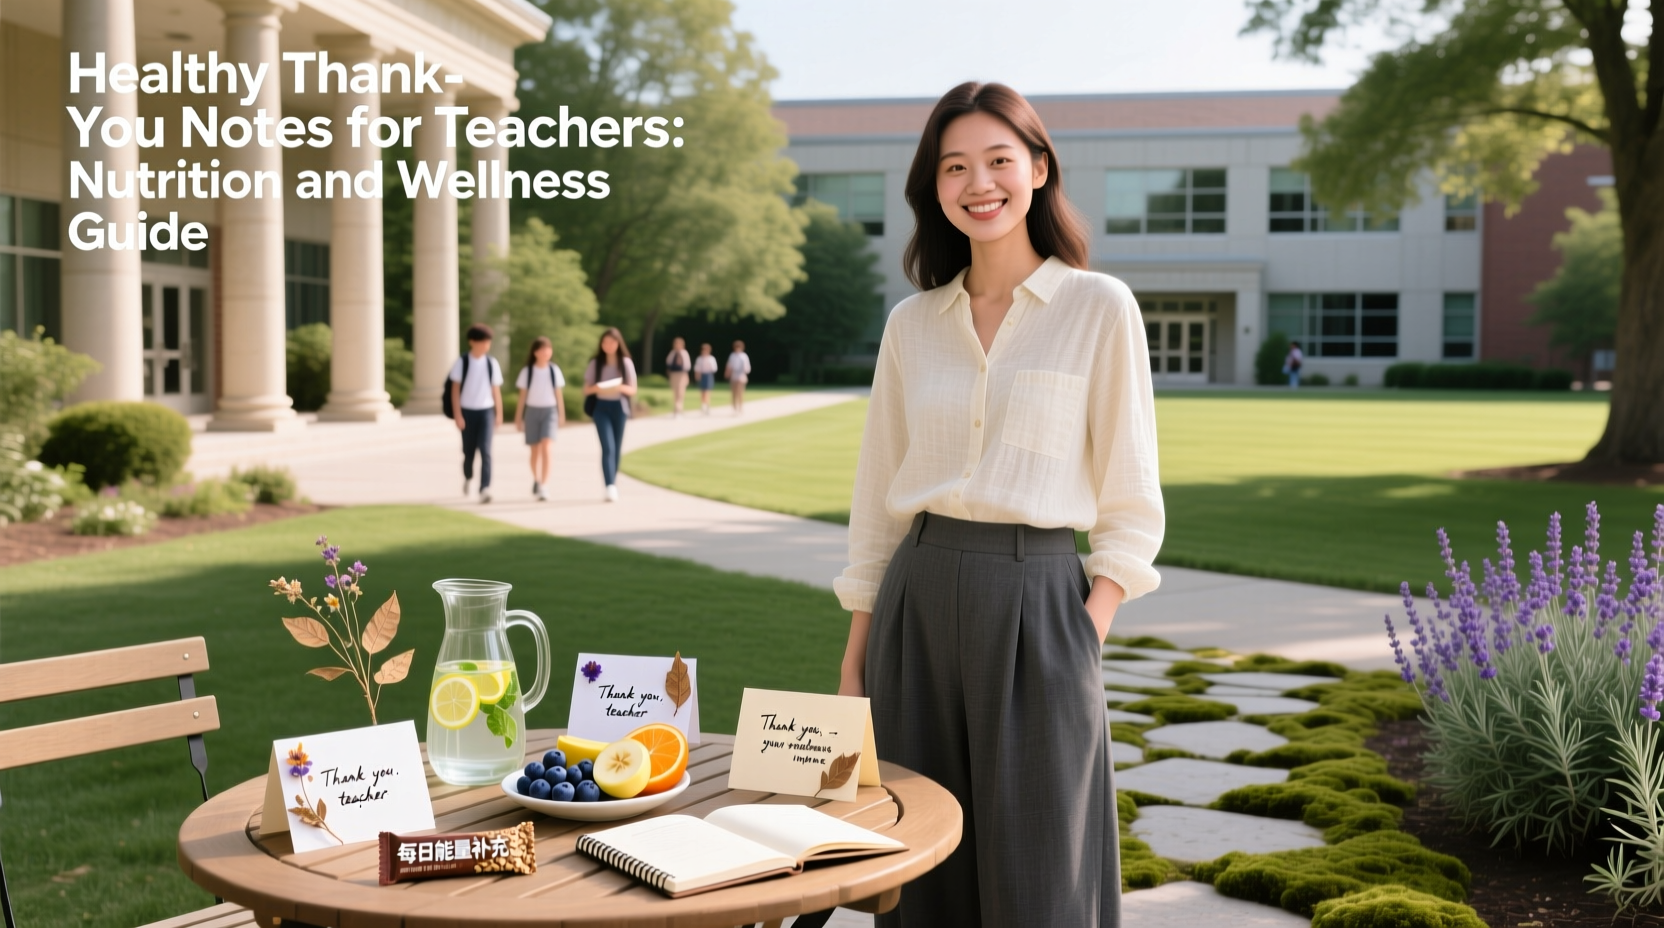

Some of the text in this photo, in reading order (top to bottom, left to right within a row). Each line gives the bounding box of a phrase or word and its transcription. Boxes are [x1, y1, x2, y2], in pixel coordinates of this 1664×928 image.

[598, 684, 635, 699] Thank
[605, 702, 648, 718] teacher
[760, 713, 796, 732] Thank
[320, 765, 366, 788] Thank
[337, 785, 388, 809] teacher
